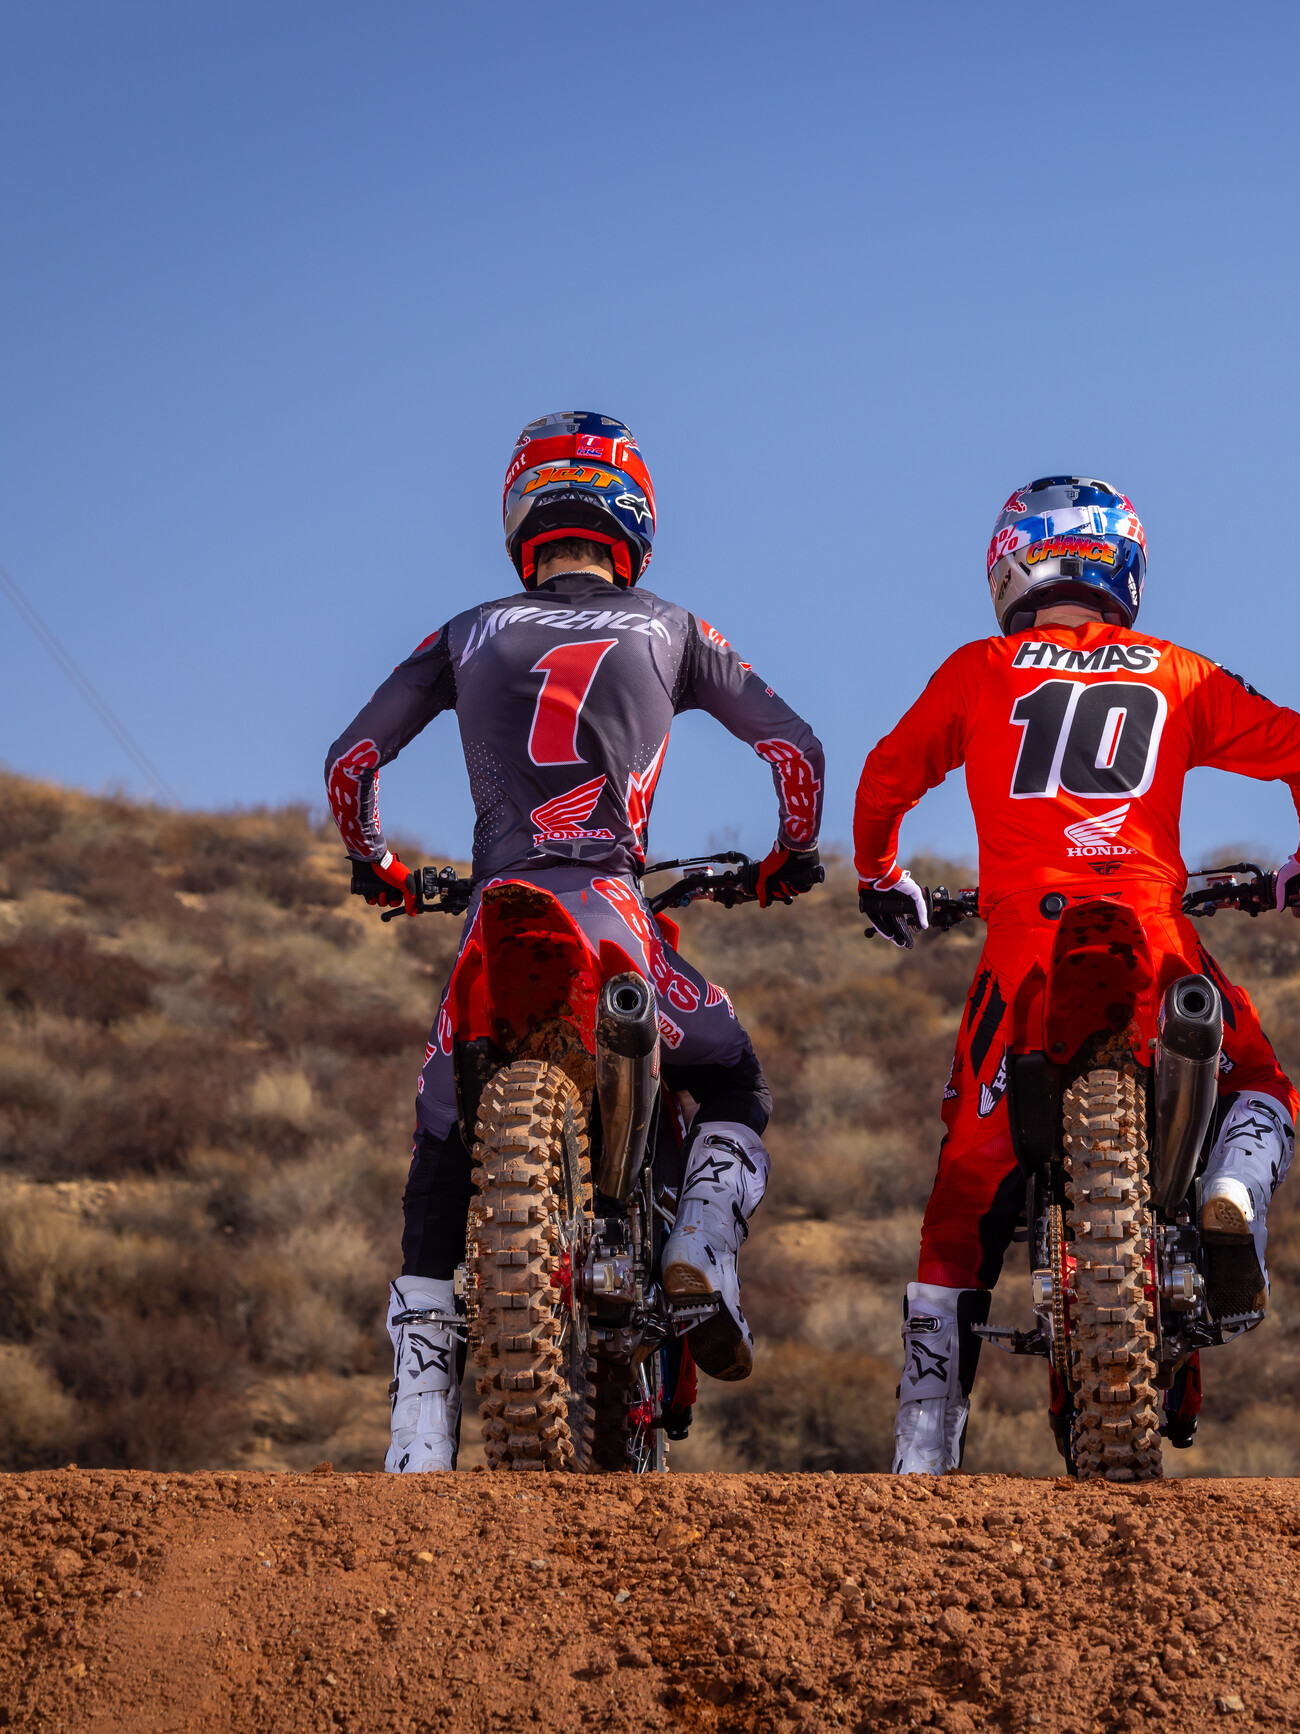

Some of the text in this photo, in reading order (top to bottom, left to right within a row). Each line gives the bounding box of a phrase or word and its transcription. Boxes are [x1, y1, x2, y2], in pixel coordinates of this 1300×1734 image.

[1026, 535, 1118, 567] CHANCE
[459, 606, 672, 667] LAWRENCE
[1012, 641, 1161, 674] HYMAS
[528, 637, 619, 766] 1
[1009, 678, 1168, 799] 10
[533, 828, 615, 849] HONDA
[1066, 845, 1139, 857] HONDA
[659, 1013, 682, 1048] NDA
